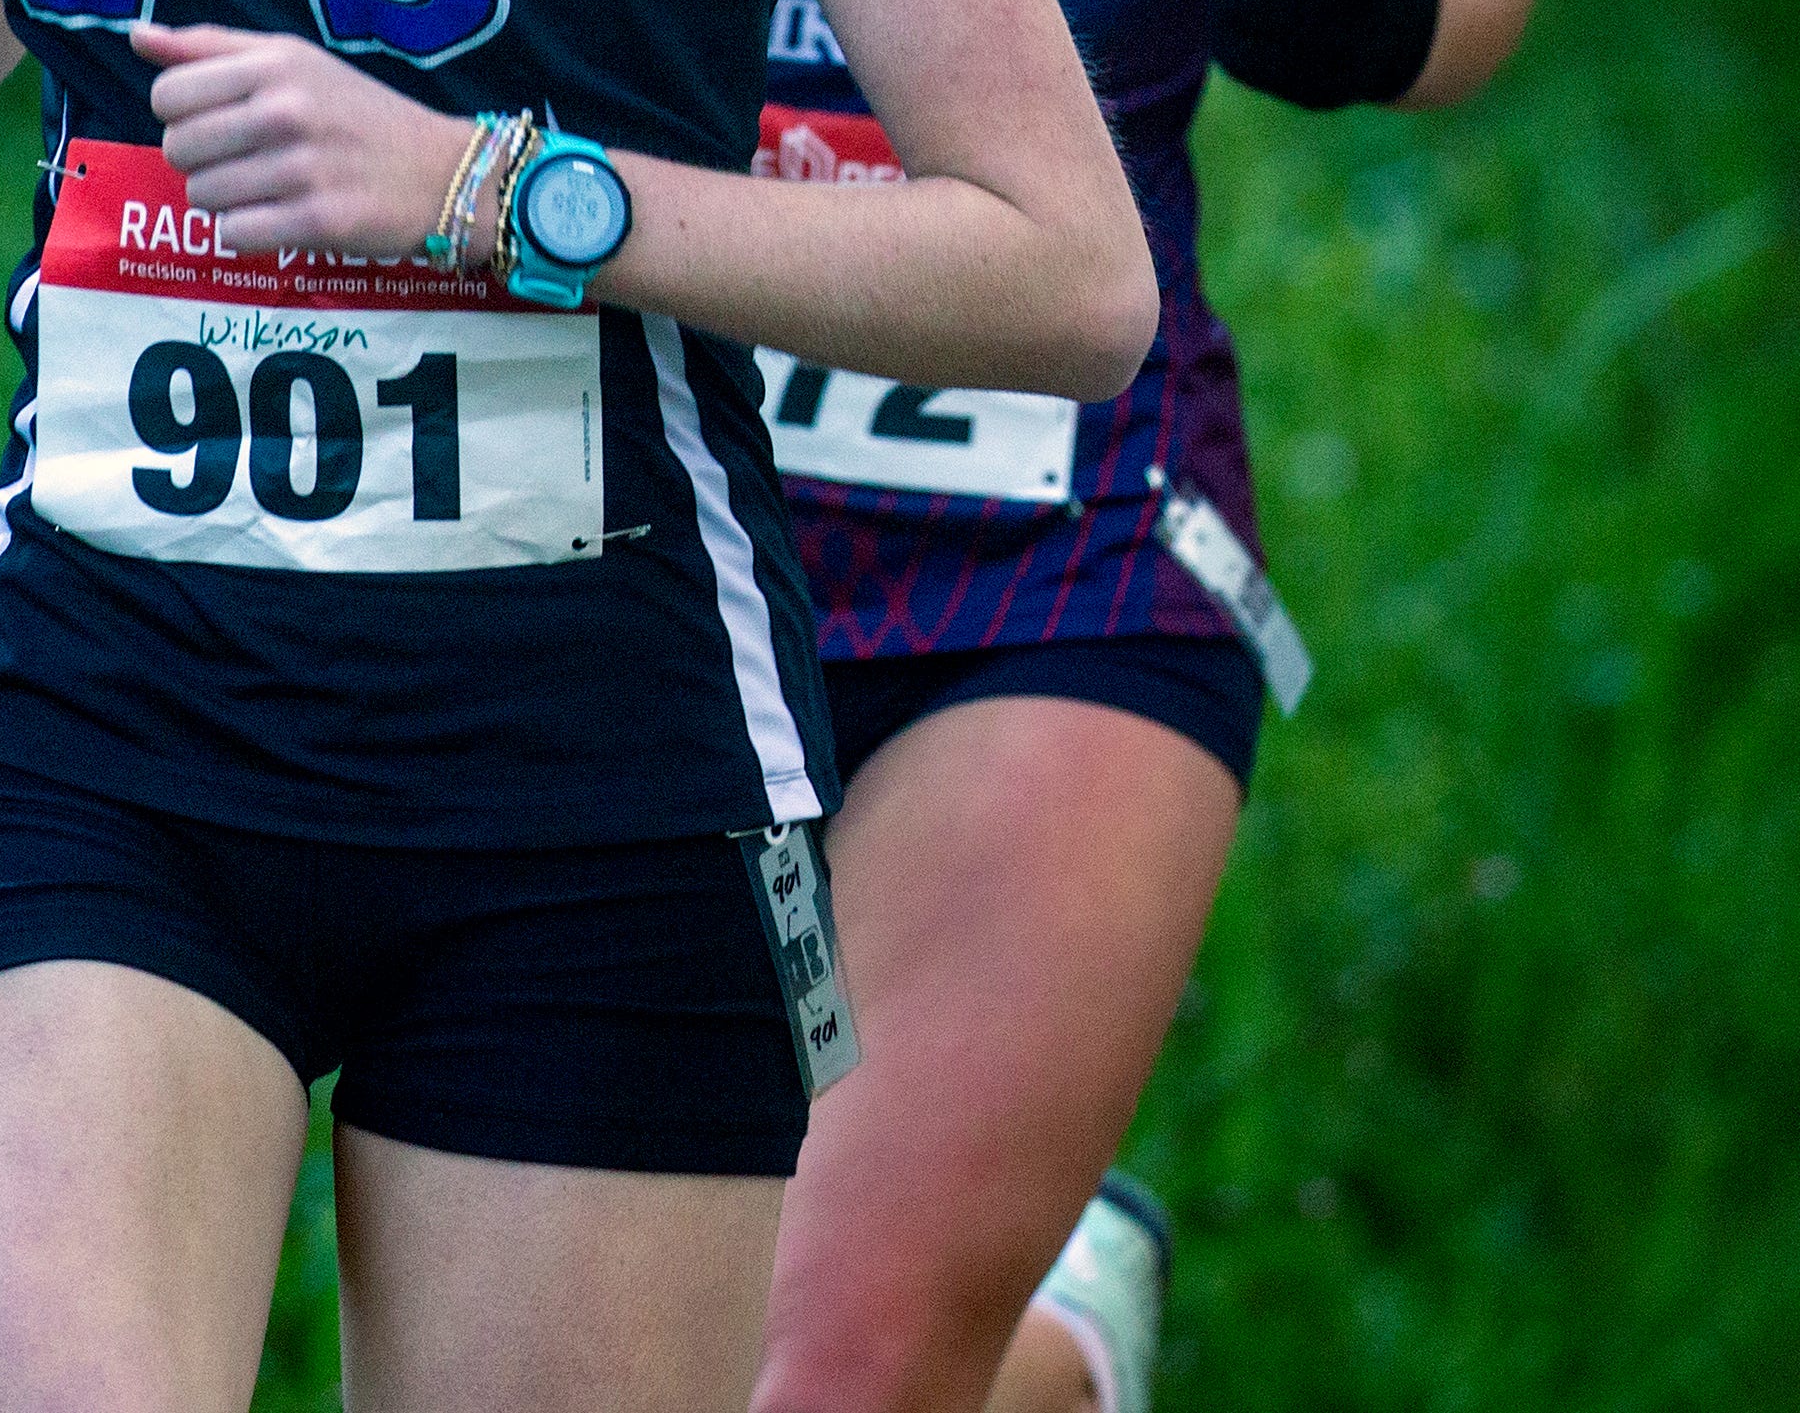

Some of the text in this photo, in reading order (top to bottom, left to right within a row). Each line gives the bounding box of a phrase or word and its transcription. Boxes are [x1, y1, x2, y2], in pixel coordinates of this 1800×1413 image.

[118, 257, 487, 299] Precision Passion German Engineering
[199, 309, 369, 353] Wilkinson
[128, 340, 462, 522] 901
[773, 861, 801, 904] 901
[810, 1010, 838, 1051] 901
